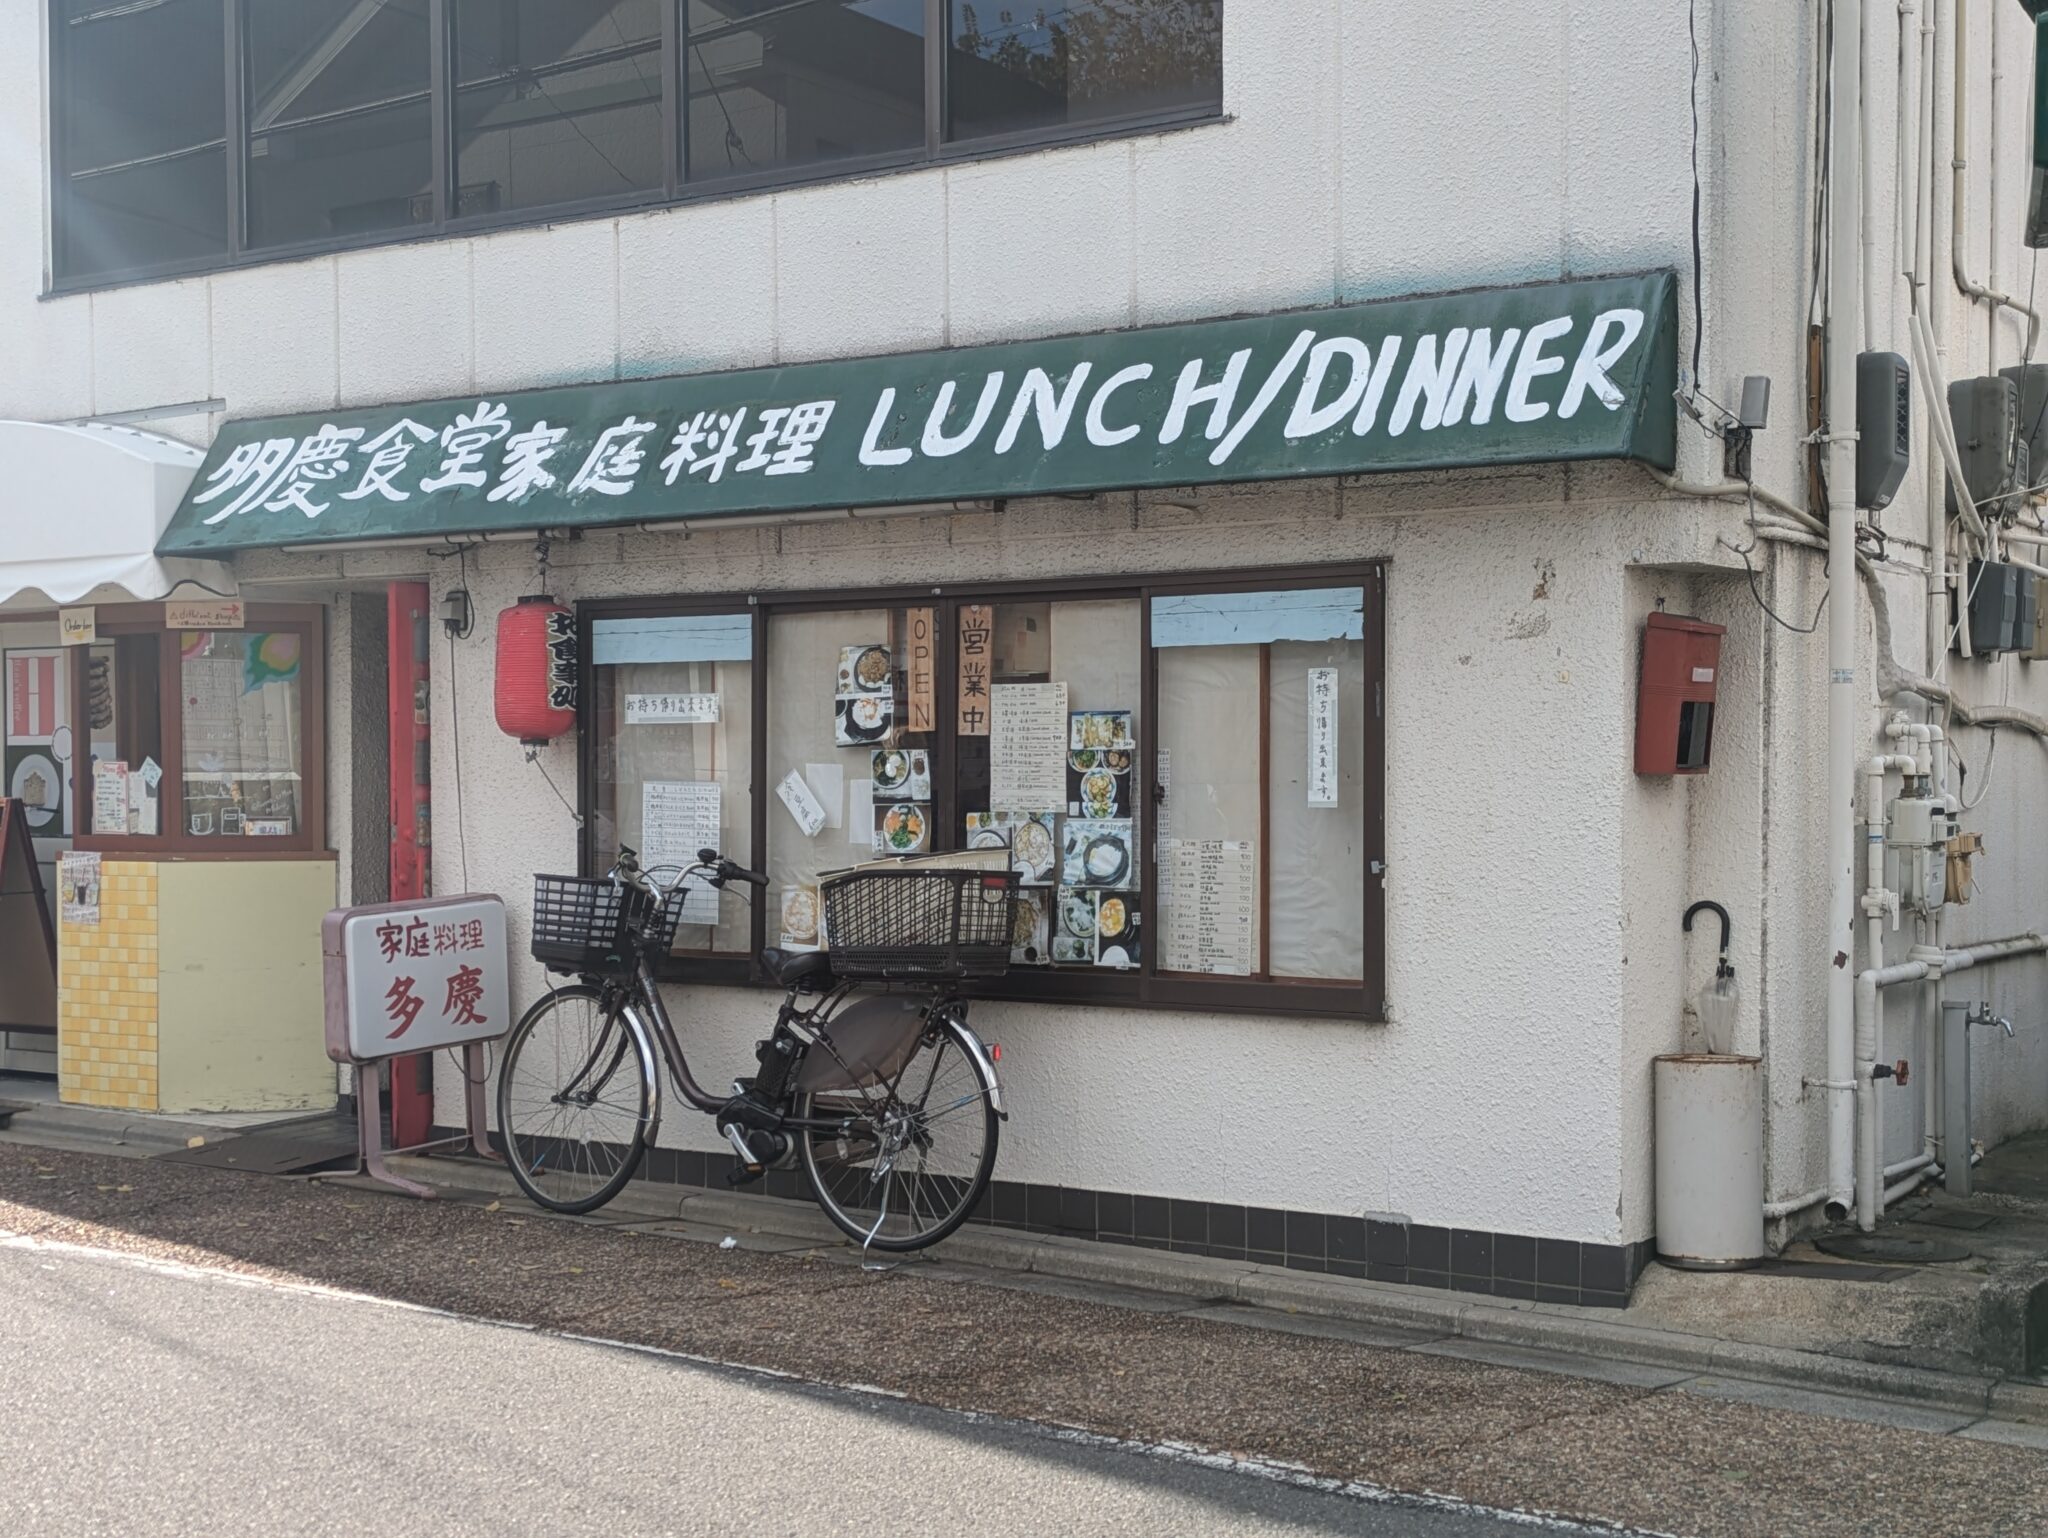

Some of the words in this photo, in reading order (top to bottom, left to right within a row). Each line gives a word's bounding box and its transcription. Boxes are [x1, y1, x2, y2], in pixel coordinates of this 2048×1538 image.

[857, 309, 1644, 466] LUNCH/DINNER
[914, 618, 931, 728] OPEN
[962, 618, 990, 733] 営業中
[376, 915, 485, 964] 家庭料理
[385, 964, 488, 1040] 多慶
